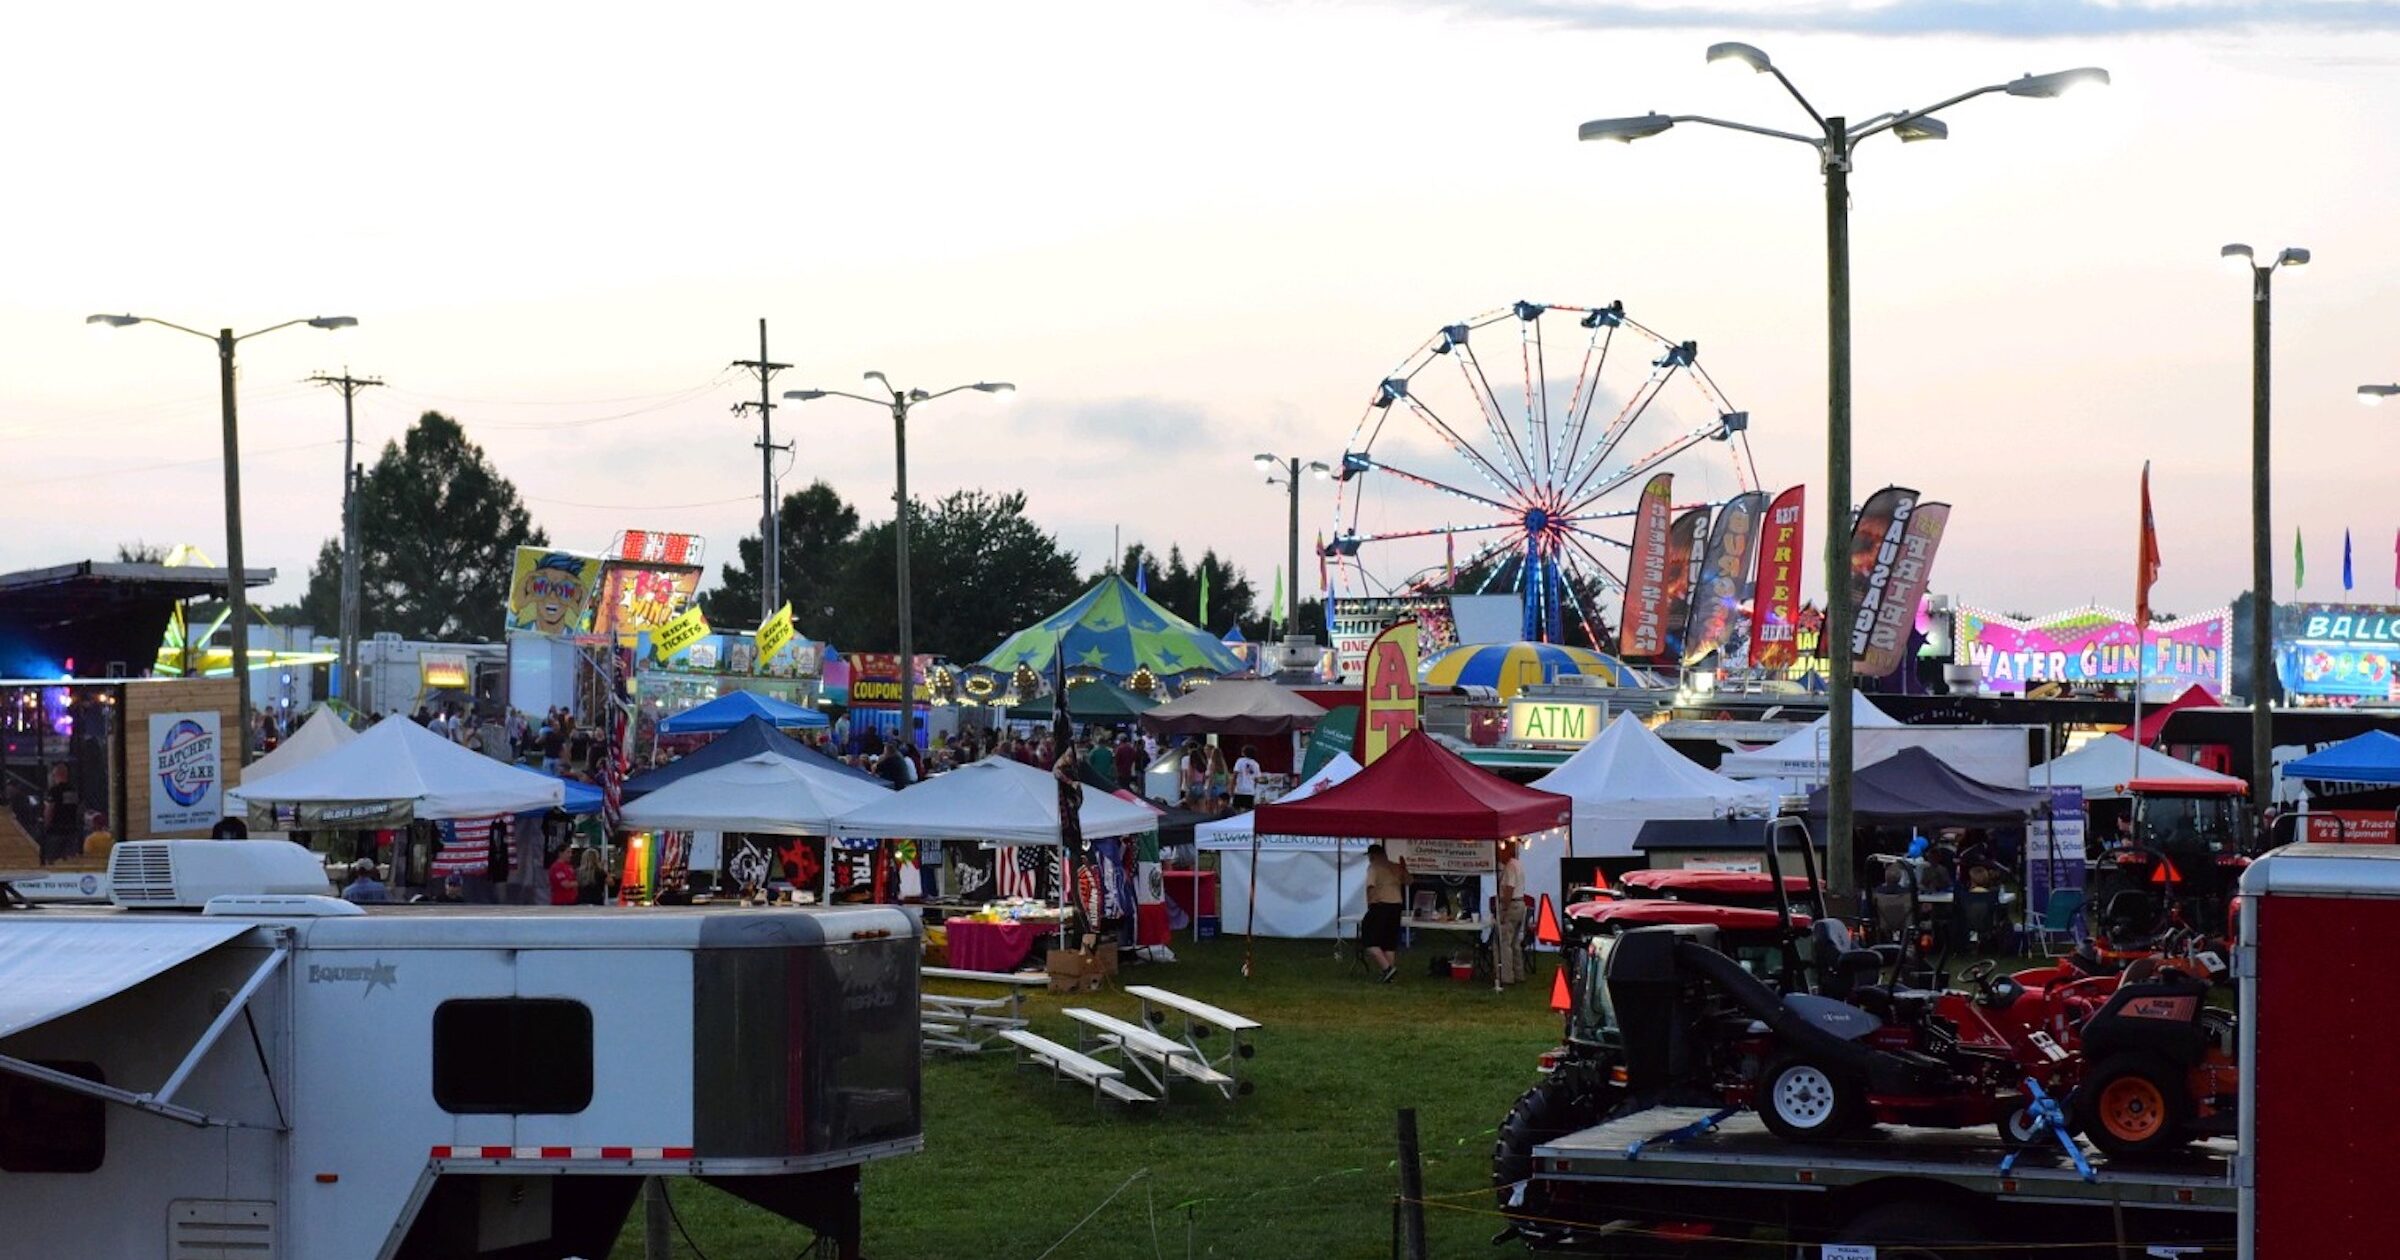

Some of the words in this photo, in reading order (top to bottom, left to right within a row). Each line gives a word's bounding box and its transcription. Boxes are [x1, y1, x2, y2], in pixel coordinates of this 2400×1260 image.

[1772, 527, 1794, 621] FRIES
[661, 619, 690, 639] RIDE
[661, 623, 702, 652] TICKETS
[763, 618, 782, 639] RIDE
[1760, 623, 1796, 642] HERE!
[1342, 640, 1369, 652] ONE
[1966, 639, 2067, 682] WATER
[2079, 640, 2140, 677] GUN
[2155, 636, 2217, 678] FUN
[1525, 706, 1584, 739] ATM
[157, 738, 213, 770] HATCHET
[174, 761, 190, 788] &
[188, 765, 215, 780] AXE
[2313, 818, 2358, 831] Readng
[2319, 829, 2328, 838] &
[2331, 828, 2390, 840] Euipment
